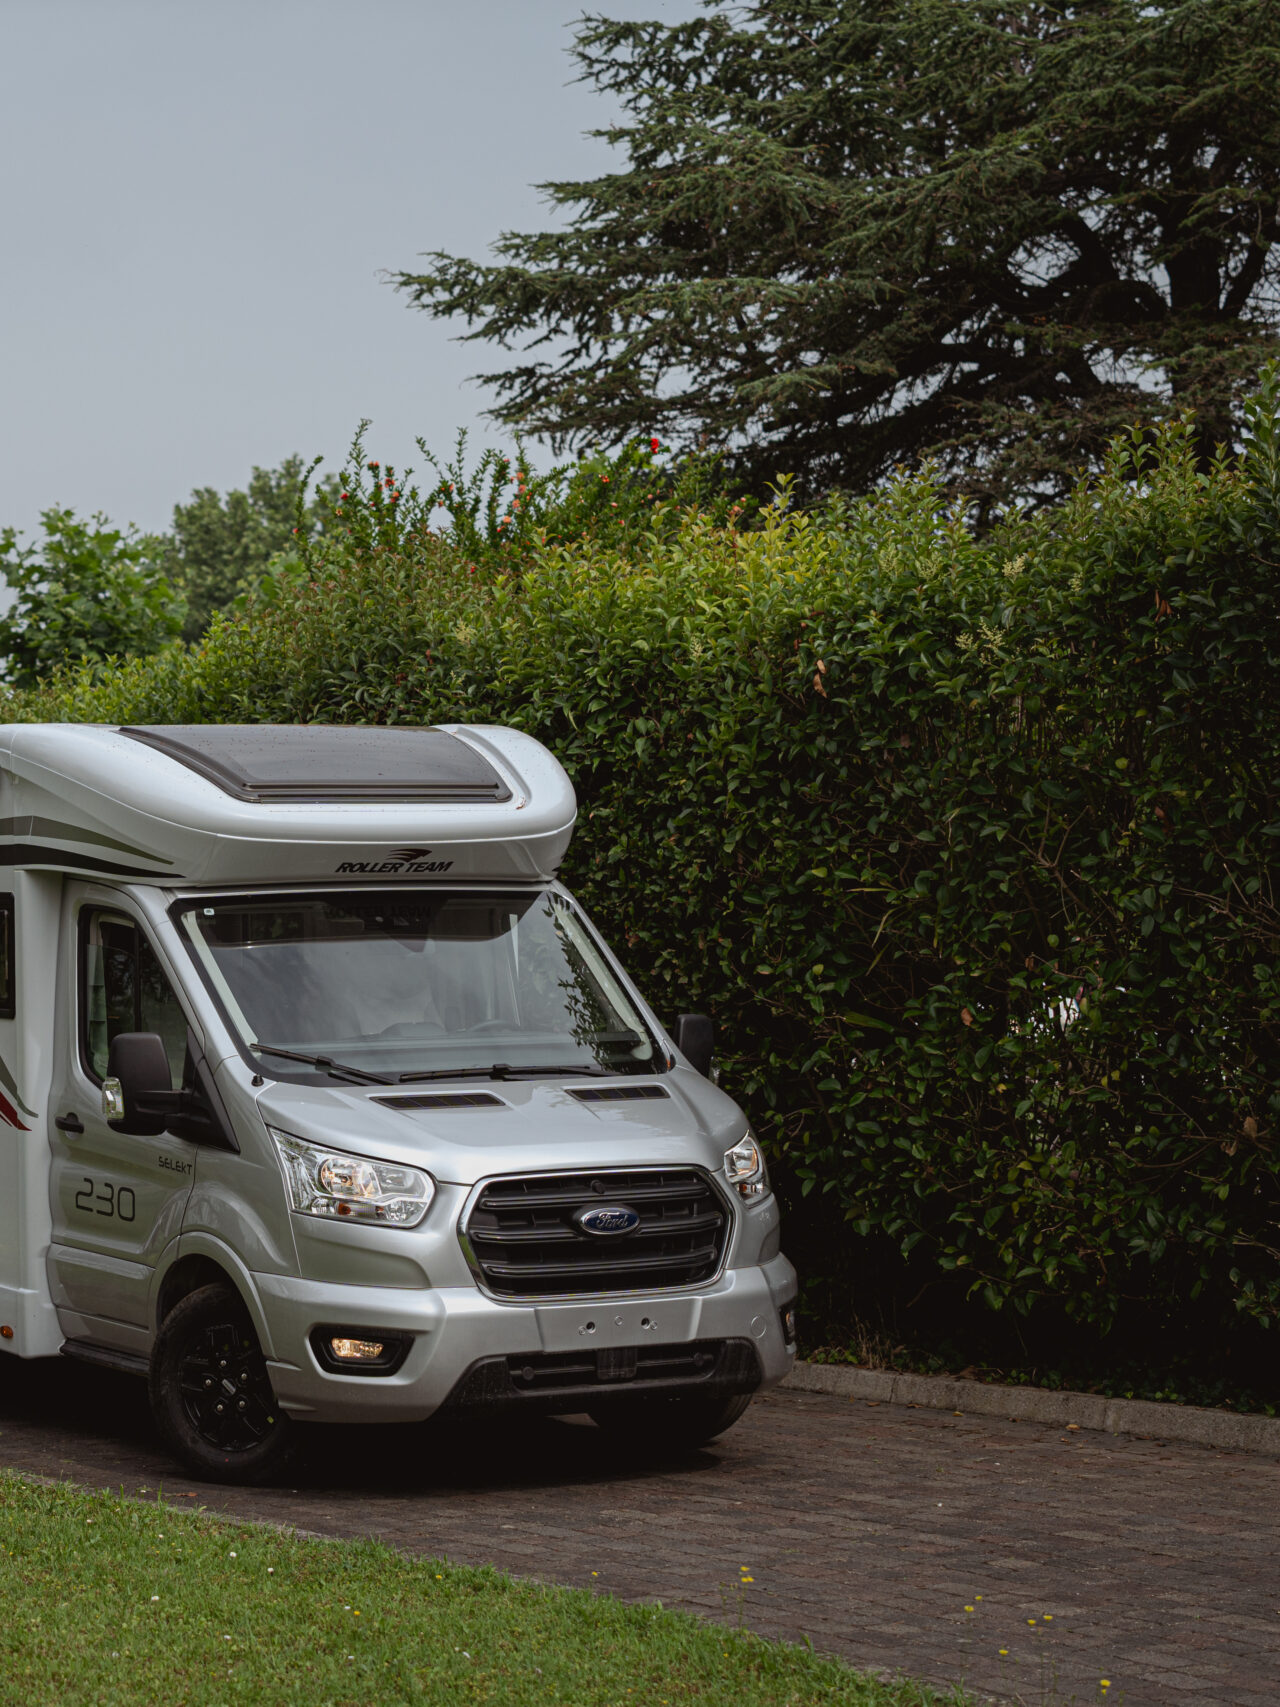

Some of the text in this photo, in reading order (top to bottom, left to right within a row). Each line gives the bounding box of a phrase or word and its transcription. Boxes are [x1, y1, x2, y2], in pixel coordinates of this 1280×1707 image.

[335, 861, 454, 873] ROLLER TEAM
[158, 1156, 193, 1175] SELEKT
[76, 1177, 135, 1222] 230
[596, 1212, 628, 1228] Ford
